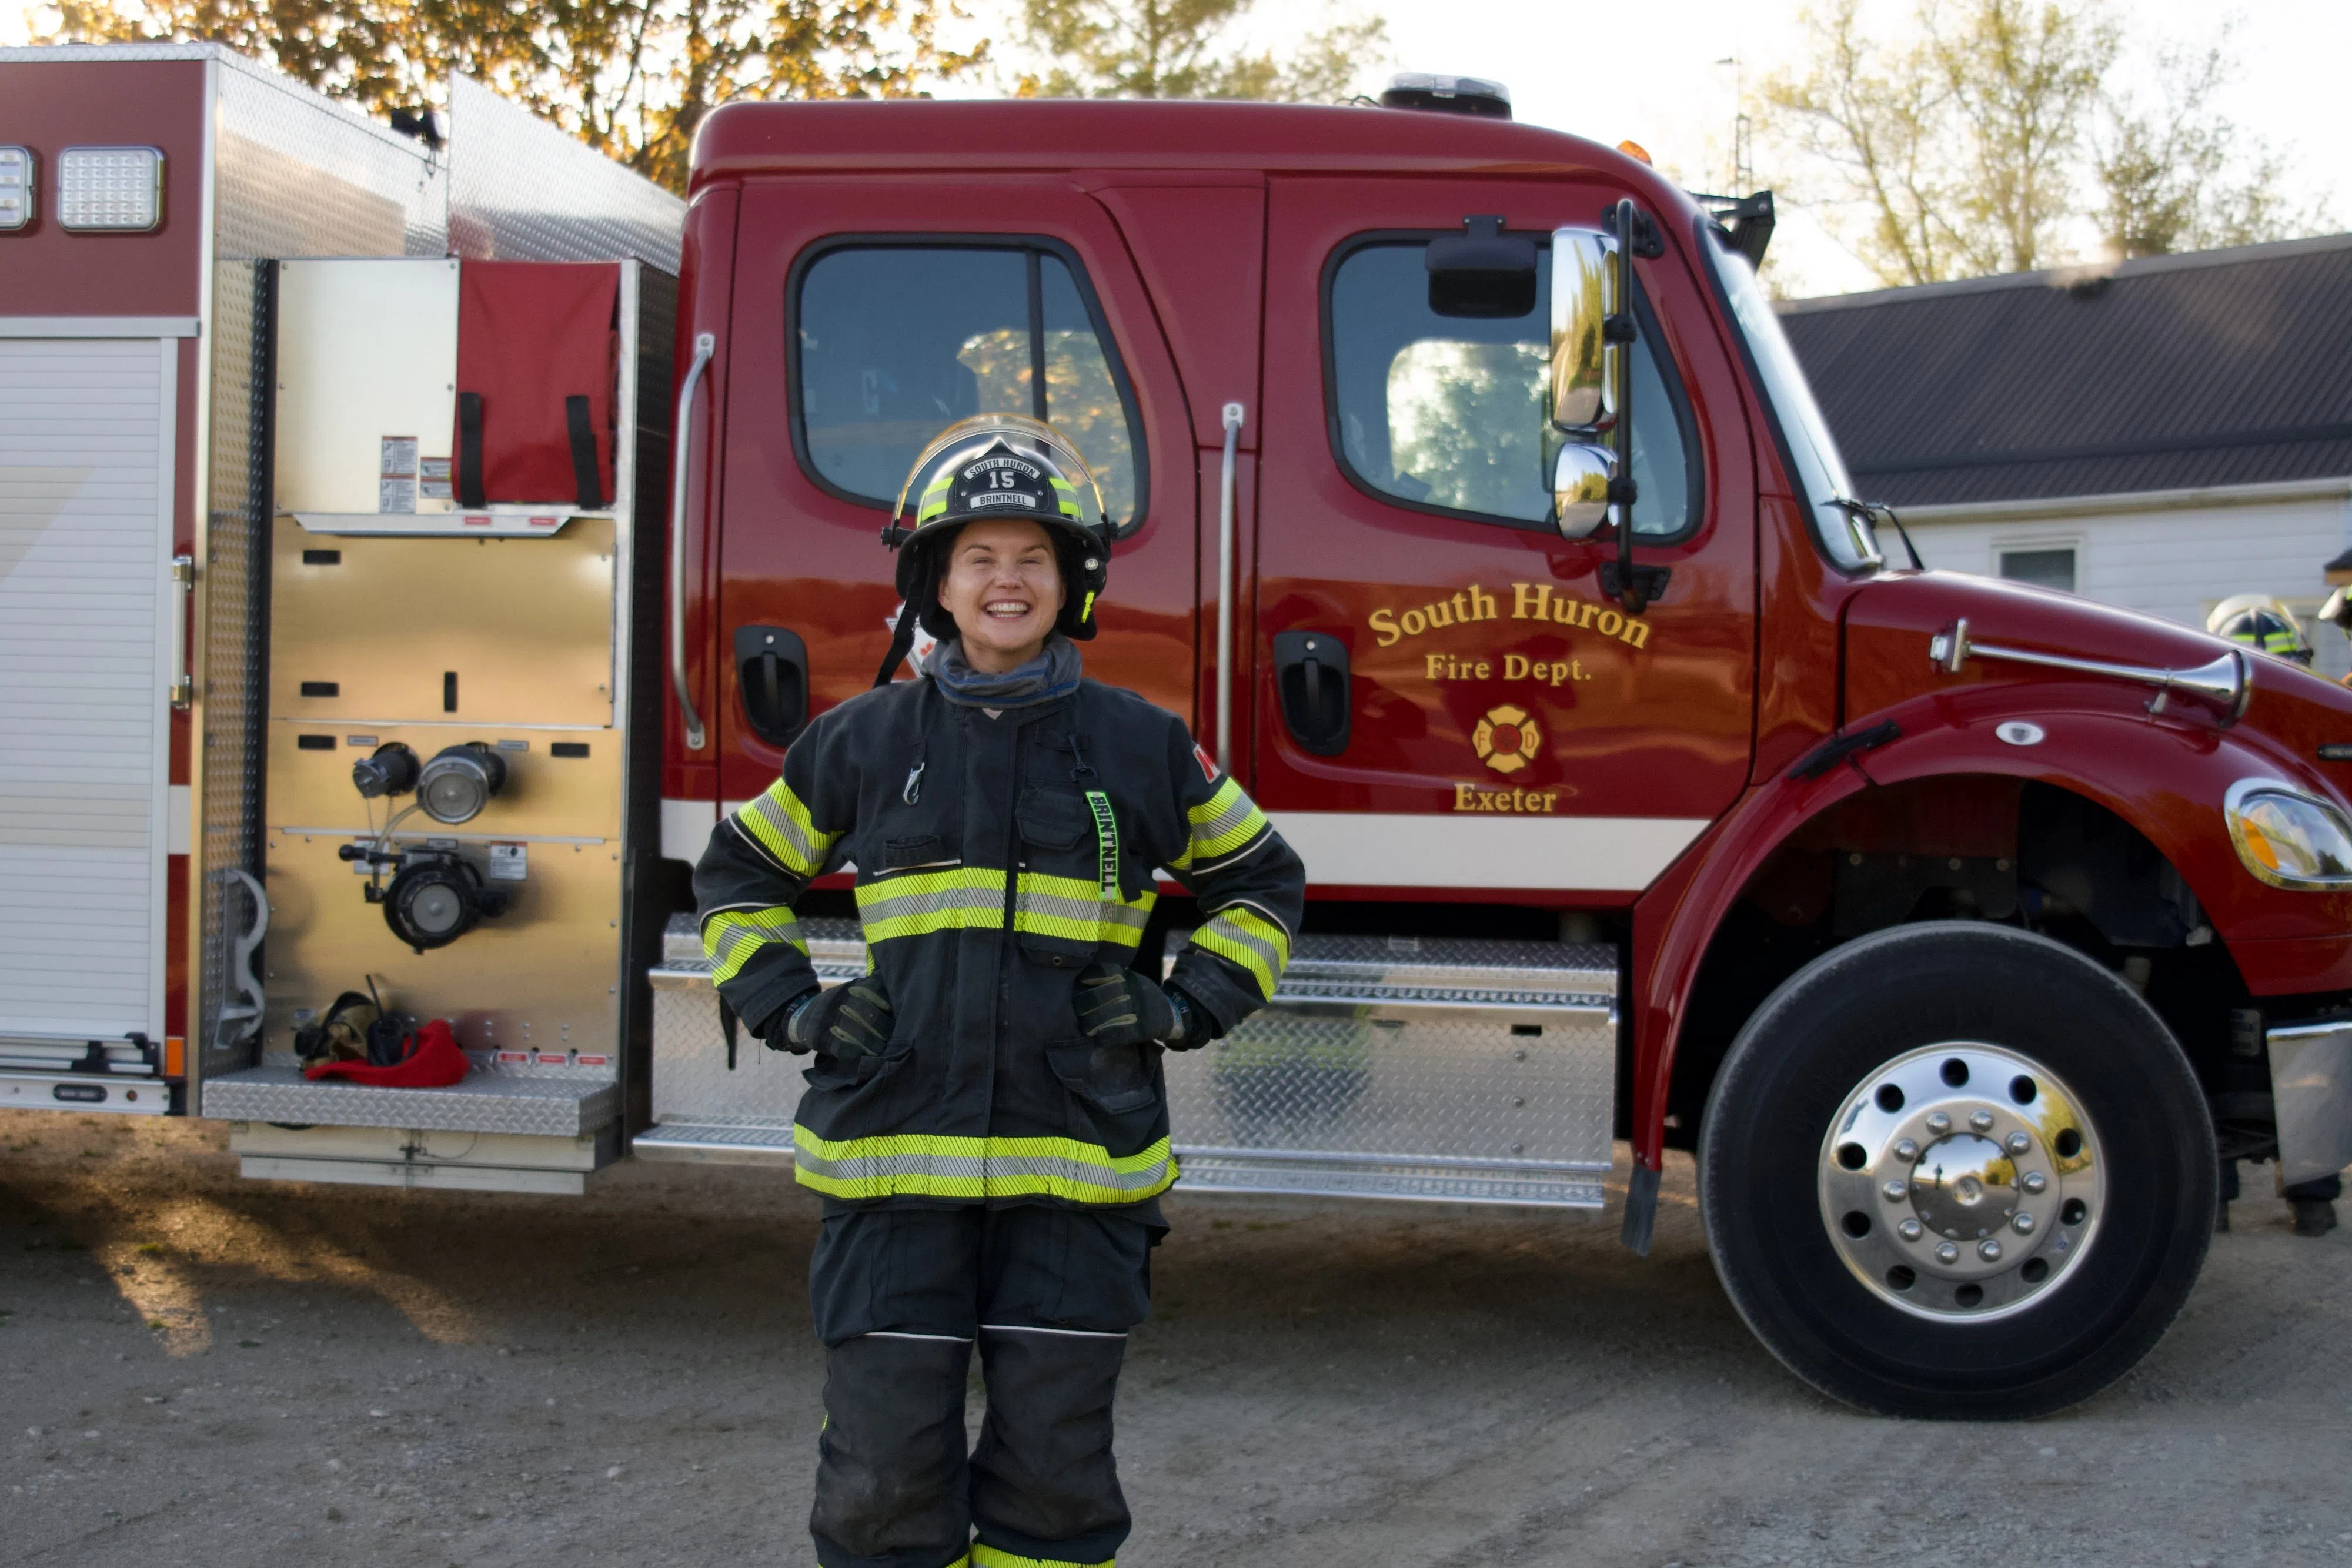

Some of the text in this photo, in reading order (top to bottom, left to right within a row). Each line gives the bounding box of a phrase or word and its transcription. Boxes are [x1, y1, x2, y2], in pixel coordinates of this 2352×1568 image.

[969, 459, 1035, 477] SOUTH HURON
[990, 471, 1014, 489] 15
[980, 494, 1027, 505] BRINTNELL
[1368, 582, 1651, 650] South Huron
[1425, 654, 1592, 687] Fire Dept.
[1478, 731, 1535, 749] F D
[1454, 783, 1558, 813] Exeter
[1089, 796, 1117, 892] BRINTNELL
